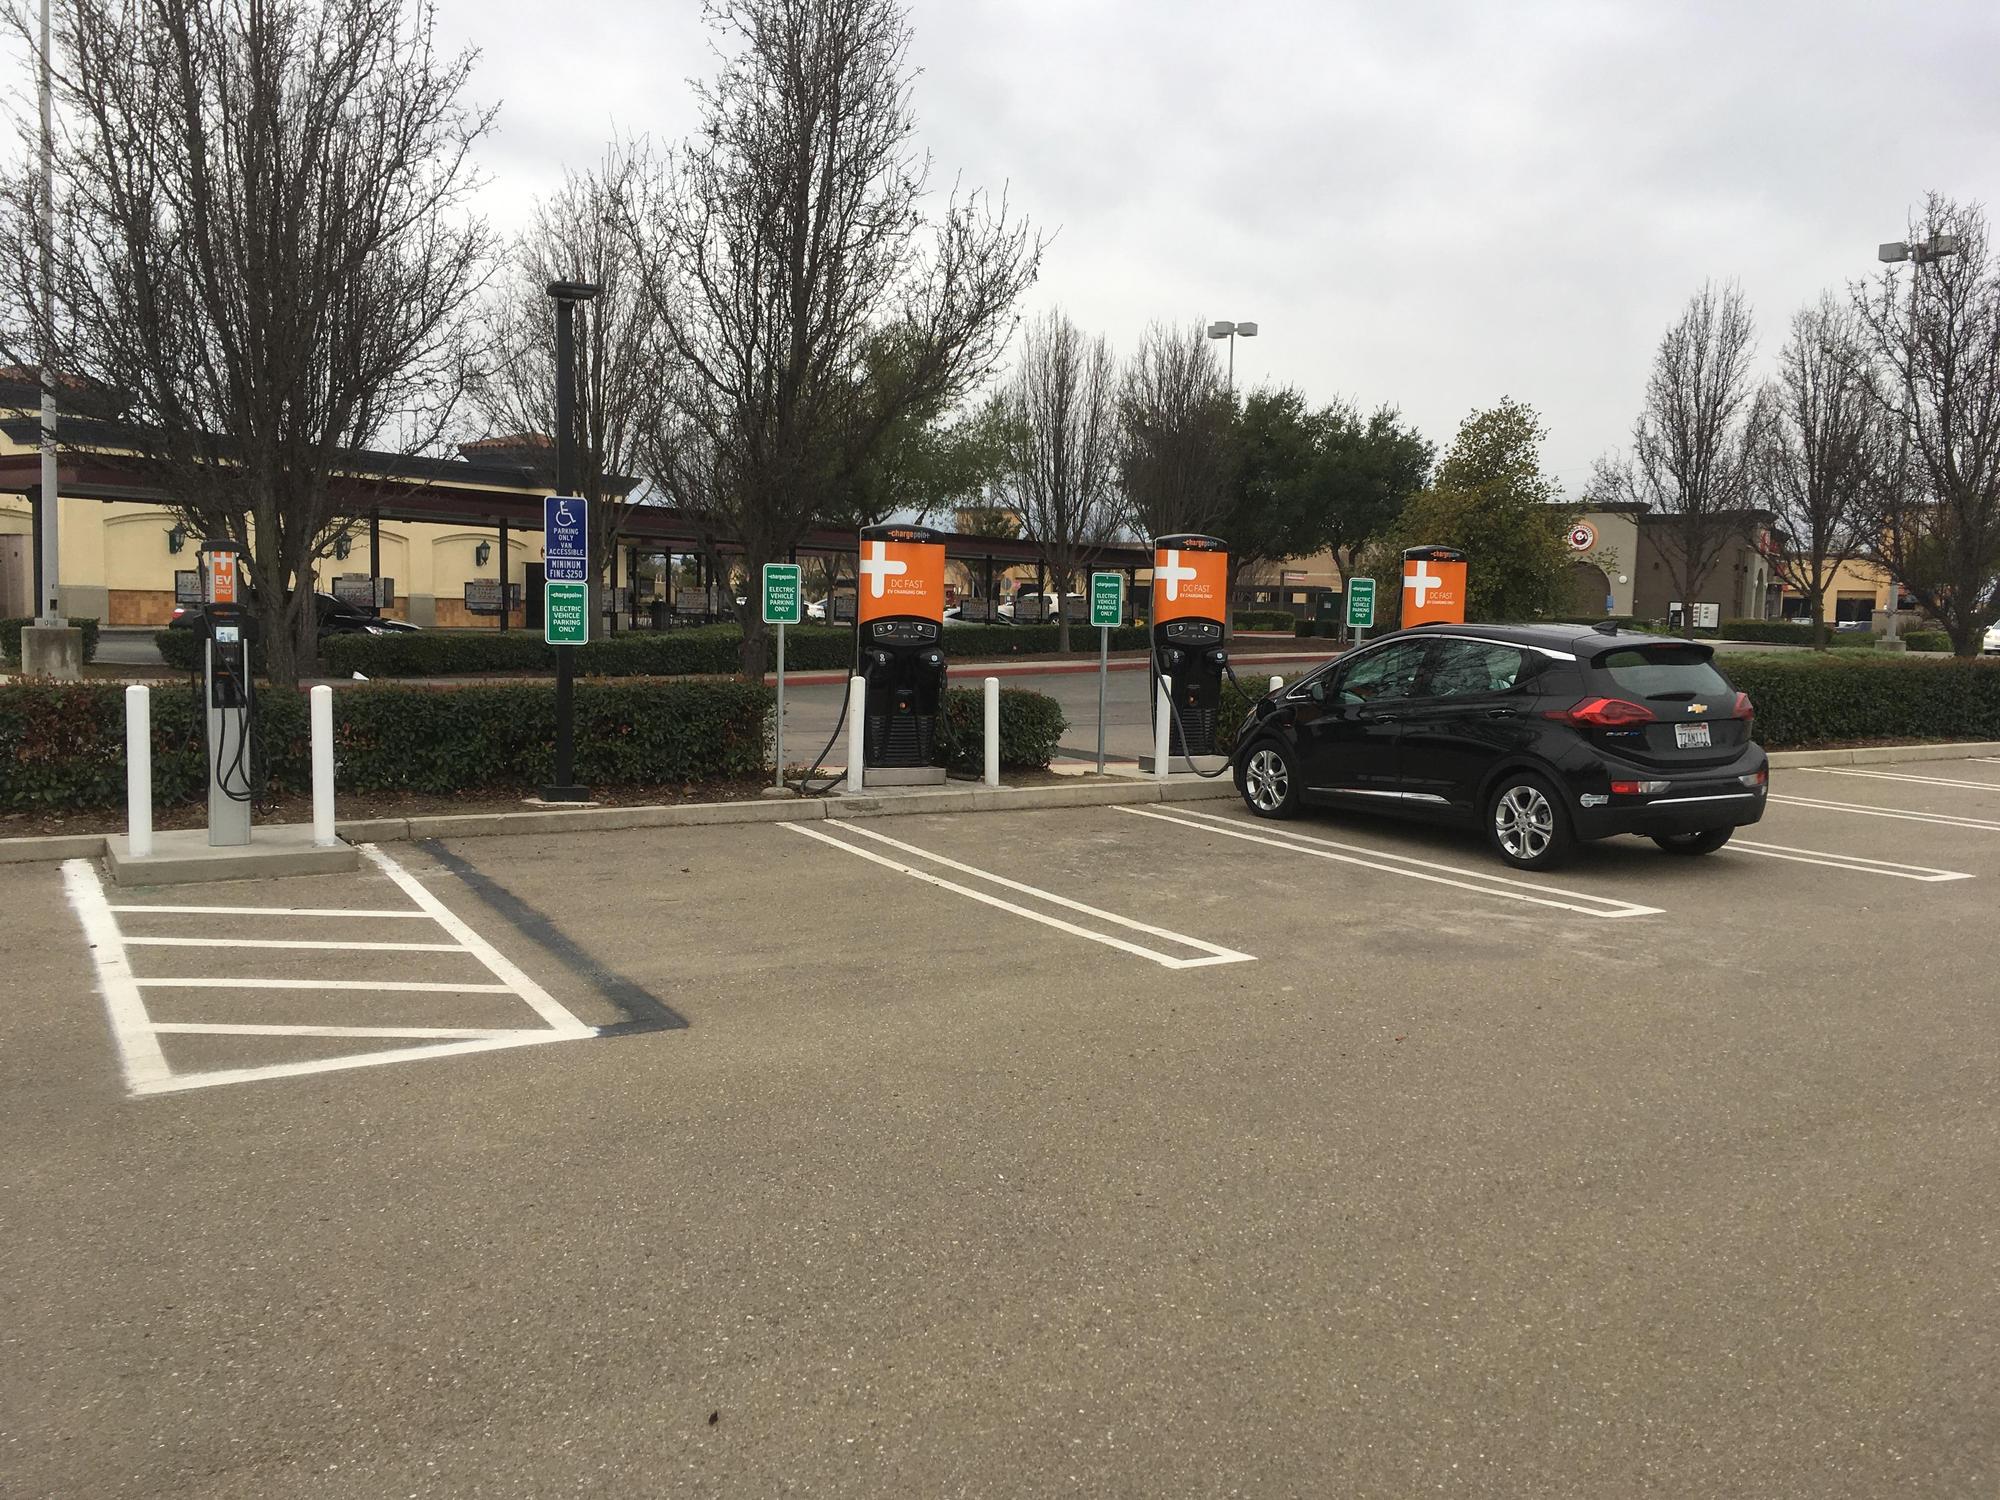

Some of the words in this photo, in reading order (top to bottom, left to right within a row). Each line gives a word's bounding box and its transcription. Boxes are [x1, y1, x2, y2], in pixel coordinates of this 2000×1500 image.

[553, 527, 579, 536] PARKING
[551, 560, 581, 569] MINIMUM
[550, 569, 565, 578] FINE
[566, 570, 583, 579] $250
[215, 575, 232, 586] EV
[891, 579, 903, 588] DC
[904, 579, 925, 589] FAST
[1183, 583, 1193, 592] DC
[1194, 583, 1211, 593] FAST
